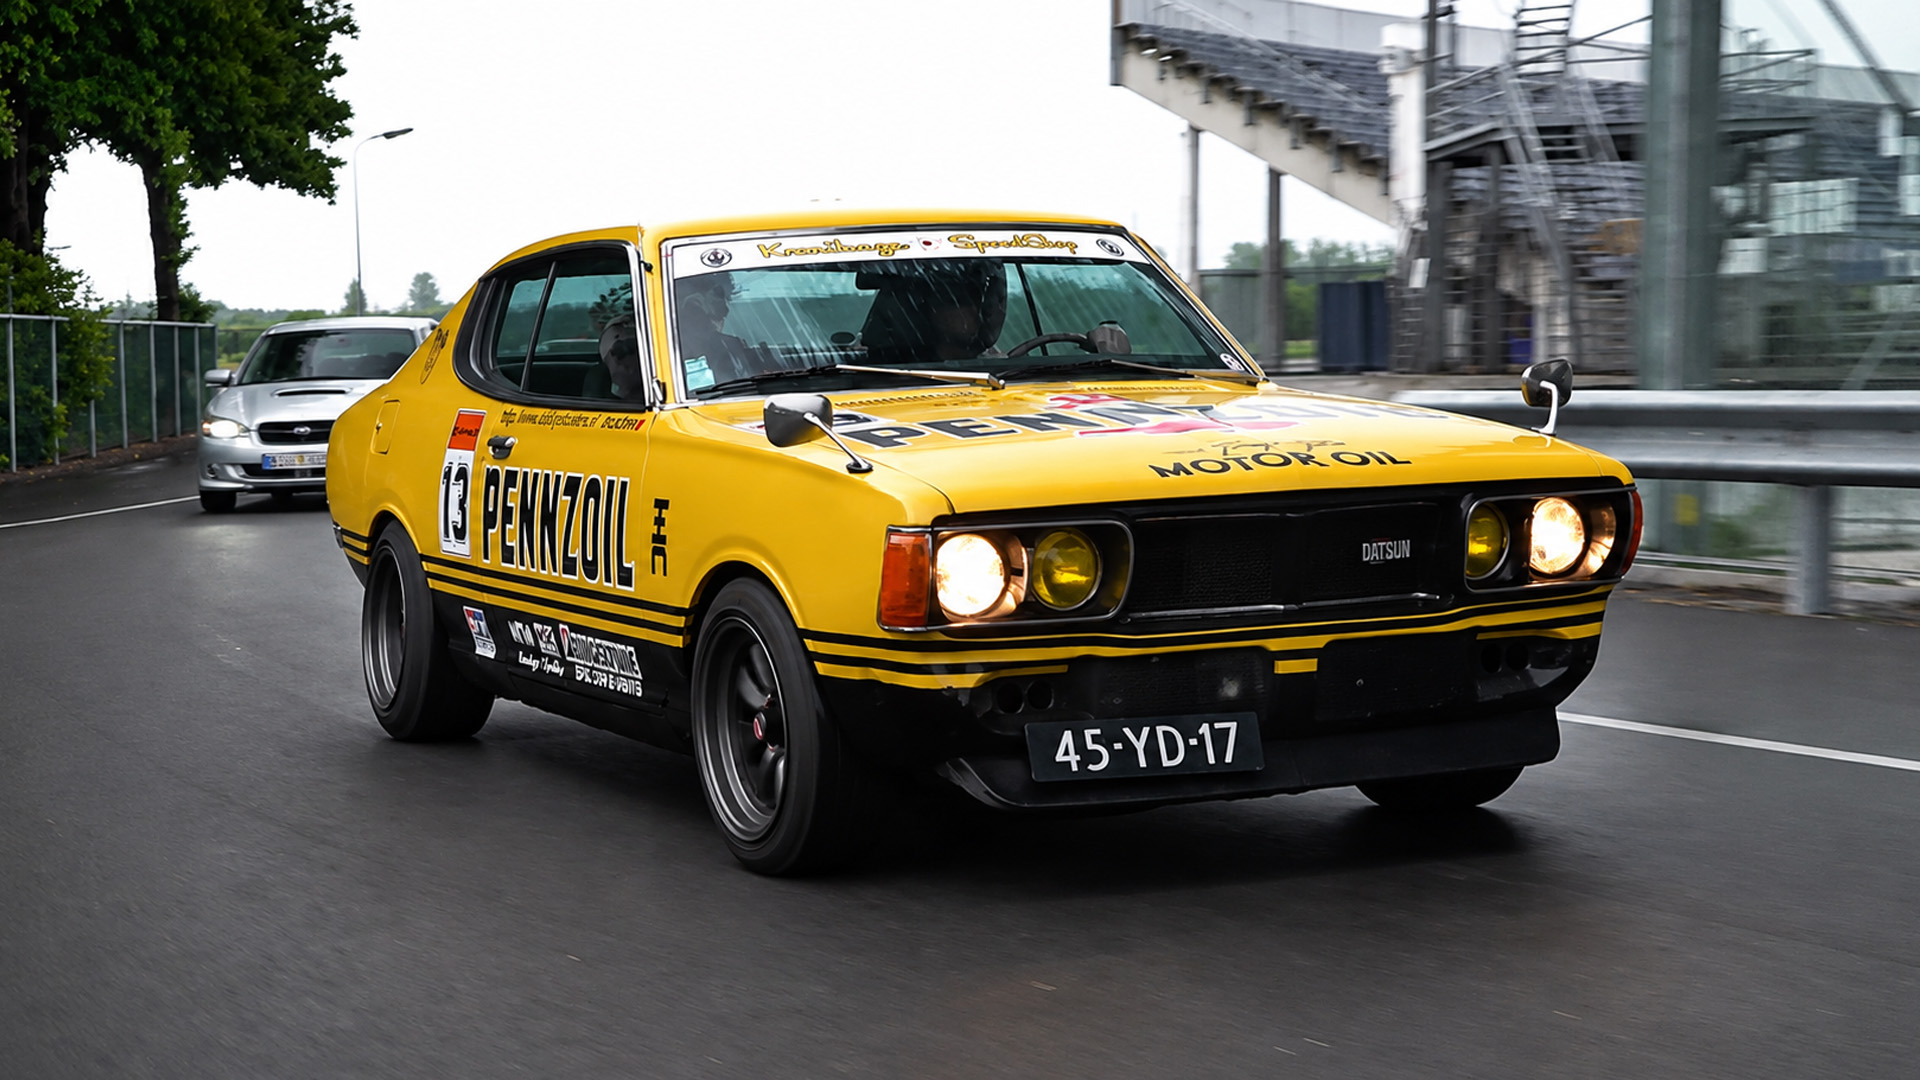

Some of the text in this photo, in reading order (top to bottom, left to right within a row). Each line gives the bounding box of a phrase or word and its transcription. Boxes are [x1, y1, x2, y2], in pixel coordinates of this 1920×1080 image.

[1148, 450, 1412, 478] MOTOR OIL
[441, 461, 471, 545] 13
[482, 464, 635, 591] PENNZOIL
[1362, 539, 1410, 561] DATSUN
[1055, 721, 1238, 772] 45-YD-17
